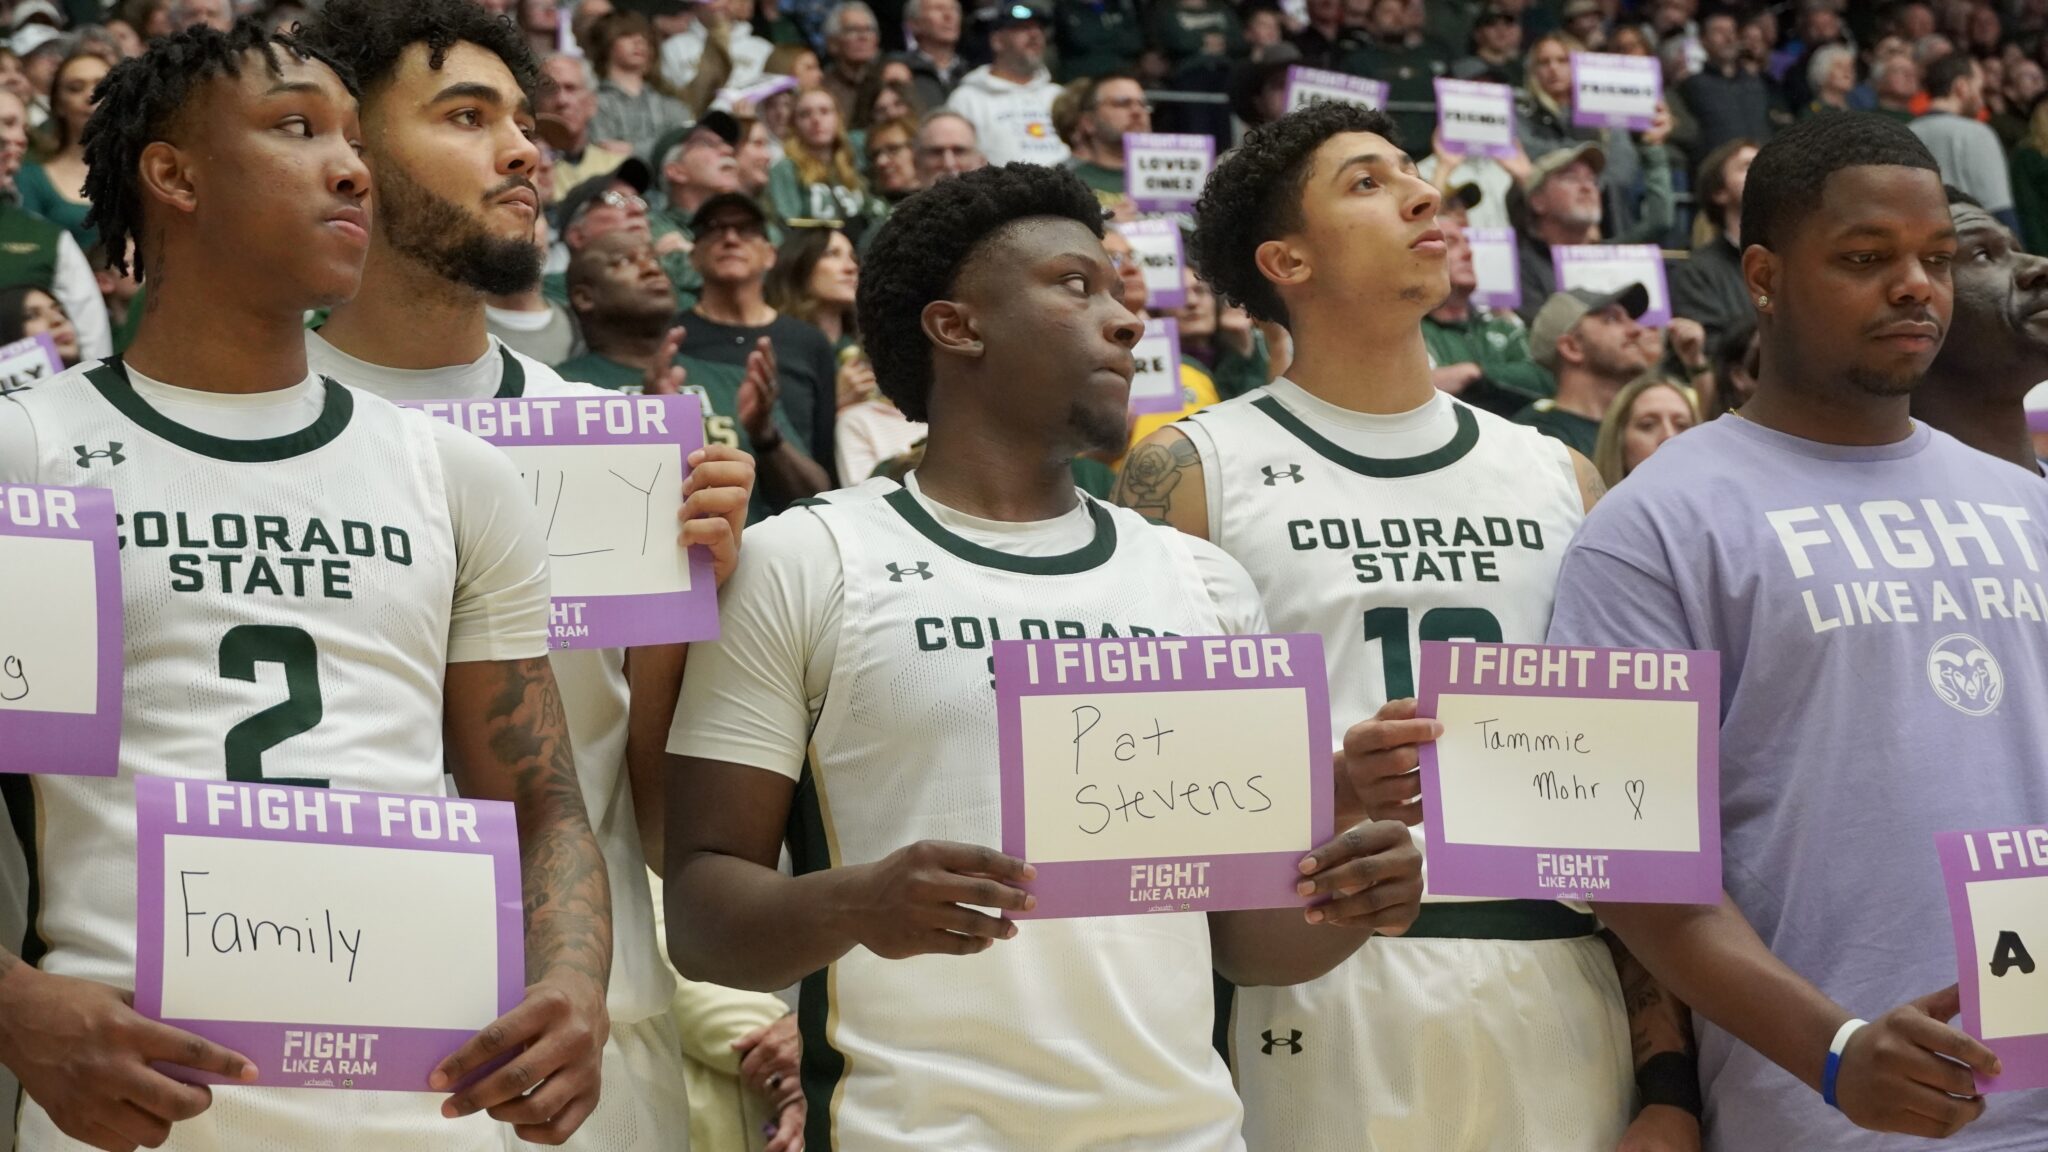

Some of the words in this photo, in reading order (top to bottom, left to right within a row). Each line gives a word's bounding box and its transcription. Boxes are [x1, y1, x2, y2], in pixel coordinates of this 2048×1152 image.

[1138, 157, 1201, 171] LOVED
[1145, 177, 1194, 190] ONES
[576, 399, 669, 435] FOR
[0, 486, 80, 529] OR
[1288, 516, 1545, 550] COLORADO
[1765, 499, 2040, 579] FIGHT
[169, 554, 353, 599] STATE
[1352, 551, 1500, 583] STATE
[1801, 581, 1919, 633] LIKE
[1932, 580, 1967, 622] A
[555, 625, 588, 637] RAM
[1026, 644, 1040, 685] I
[1054, 641, 1188, 684] FIGHT
[1203, 638, 1293, 679] FOR
[1449, 646, 1460, 684] I
[1473, 647, 1596, 688] FIGHT
[1608, 652, 1690, 691] FOR
[219, 625, 330, 788] 2
[1072, 705, 1174, 774] Pat
[1474, 718, 1591, 754] Tammie
[1533, 771, 1600, 800] Mohr
[174, 782, 187, 823] I
[206, 784, 360, 834] FIGHT
[378, 797, 481, 843] FOR
[1076, 775, 1272, 834] Stevens
[1536, 853, 1608, 876] FIGHT
[1964, 834, 1981, 871] I
[1130, 862, 1210, 888] FIGHT
[1539, 876, 1566, 888] LIKE
[1568, 877, 1578, 889] A
[1580, 877, 1610, 889] RAM
[1130, 889, 1161, 902] LIKE
[1163, 888, 1174, 900] A
[1177, 886, 1209, 900] RAM
[181, 871, 360, 982] Family
[1989, 930, 2036, 978] A
[284, 1031, 379, 1060] FIGHT
[282, 1058, 319, 1073] LIKE
[322, 1060, 335, 1074] A
[338, 1061, 377, 1075] RAM
